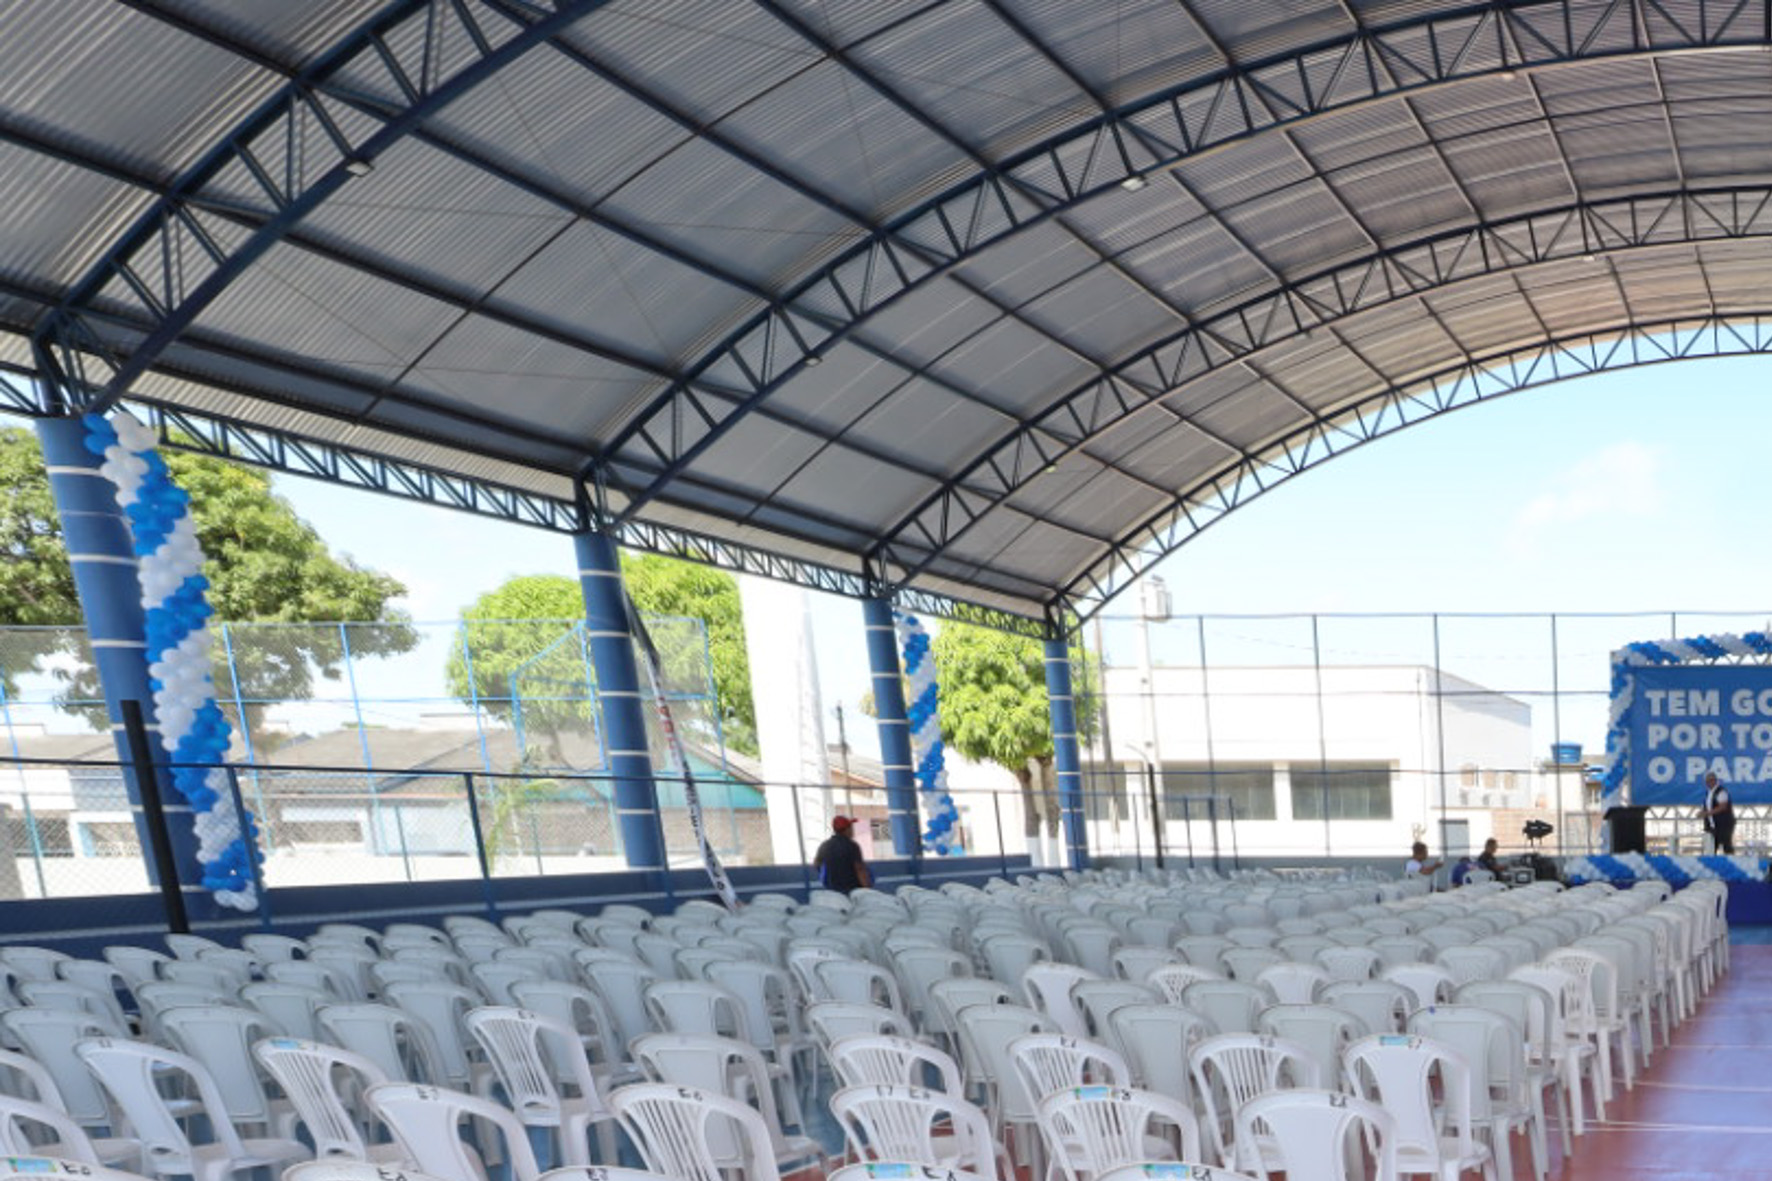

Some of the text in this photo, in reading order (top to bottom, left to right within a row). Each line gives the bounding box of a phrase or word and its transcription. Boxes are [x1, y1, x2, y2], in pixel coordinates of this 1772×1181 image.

[1645, 689, 1720, 716] TEM
[1648, 723, 1722, 750] POR
[1647, 756, 1675, 783] O
